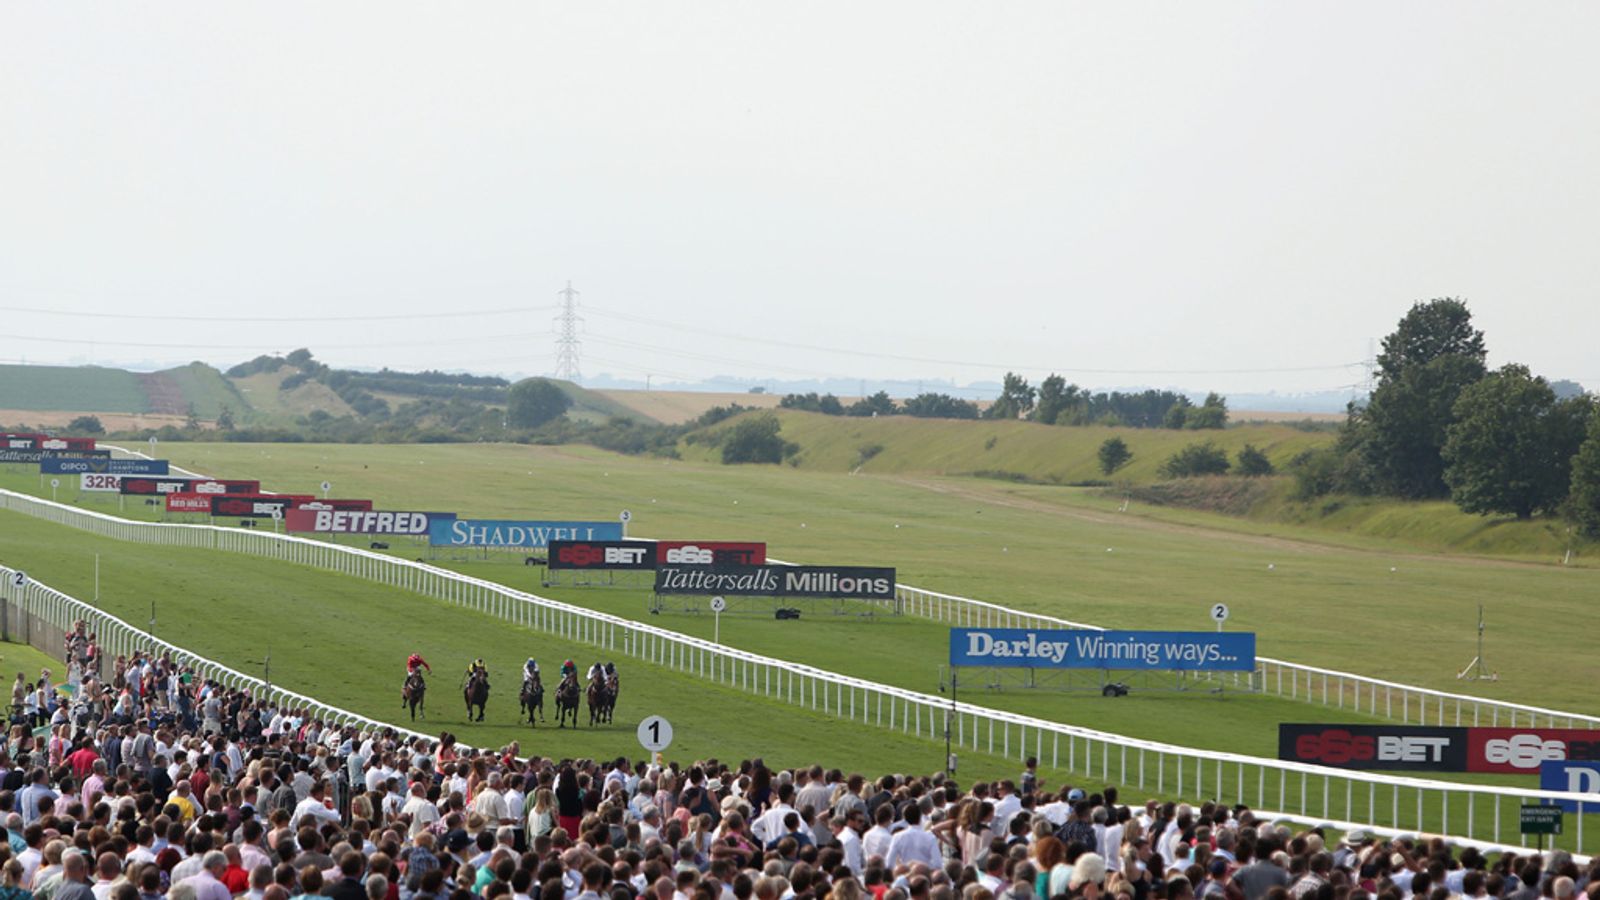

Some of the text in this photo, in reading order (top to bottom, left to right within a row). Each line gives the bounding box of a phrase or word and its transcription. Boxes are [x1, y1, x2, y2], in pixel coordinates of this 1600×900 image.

[0, 450, 53, 461] attersalls
[315, 512, 428, 533] BETFRED
[622, 511, 629, 520] 3
[451, 520, 594, 545] SHADWELL
[16, 572, 23, 584] 2
[662, 568, 889, 594] Tattersalls Millions
[1216, 606, 1225, 618] 2
[966, 632, 1070, 663] Darley
[1076, 636, 1161, 664] Winning
[648, 720, 659, 743] 1
